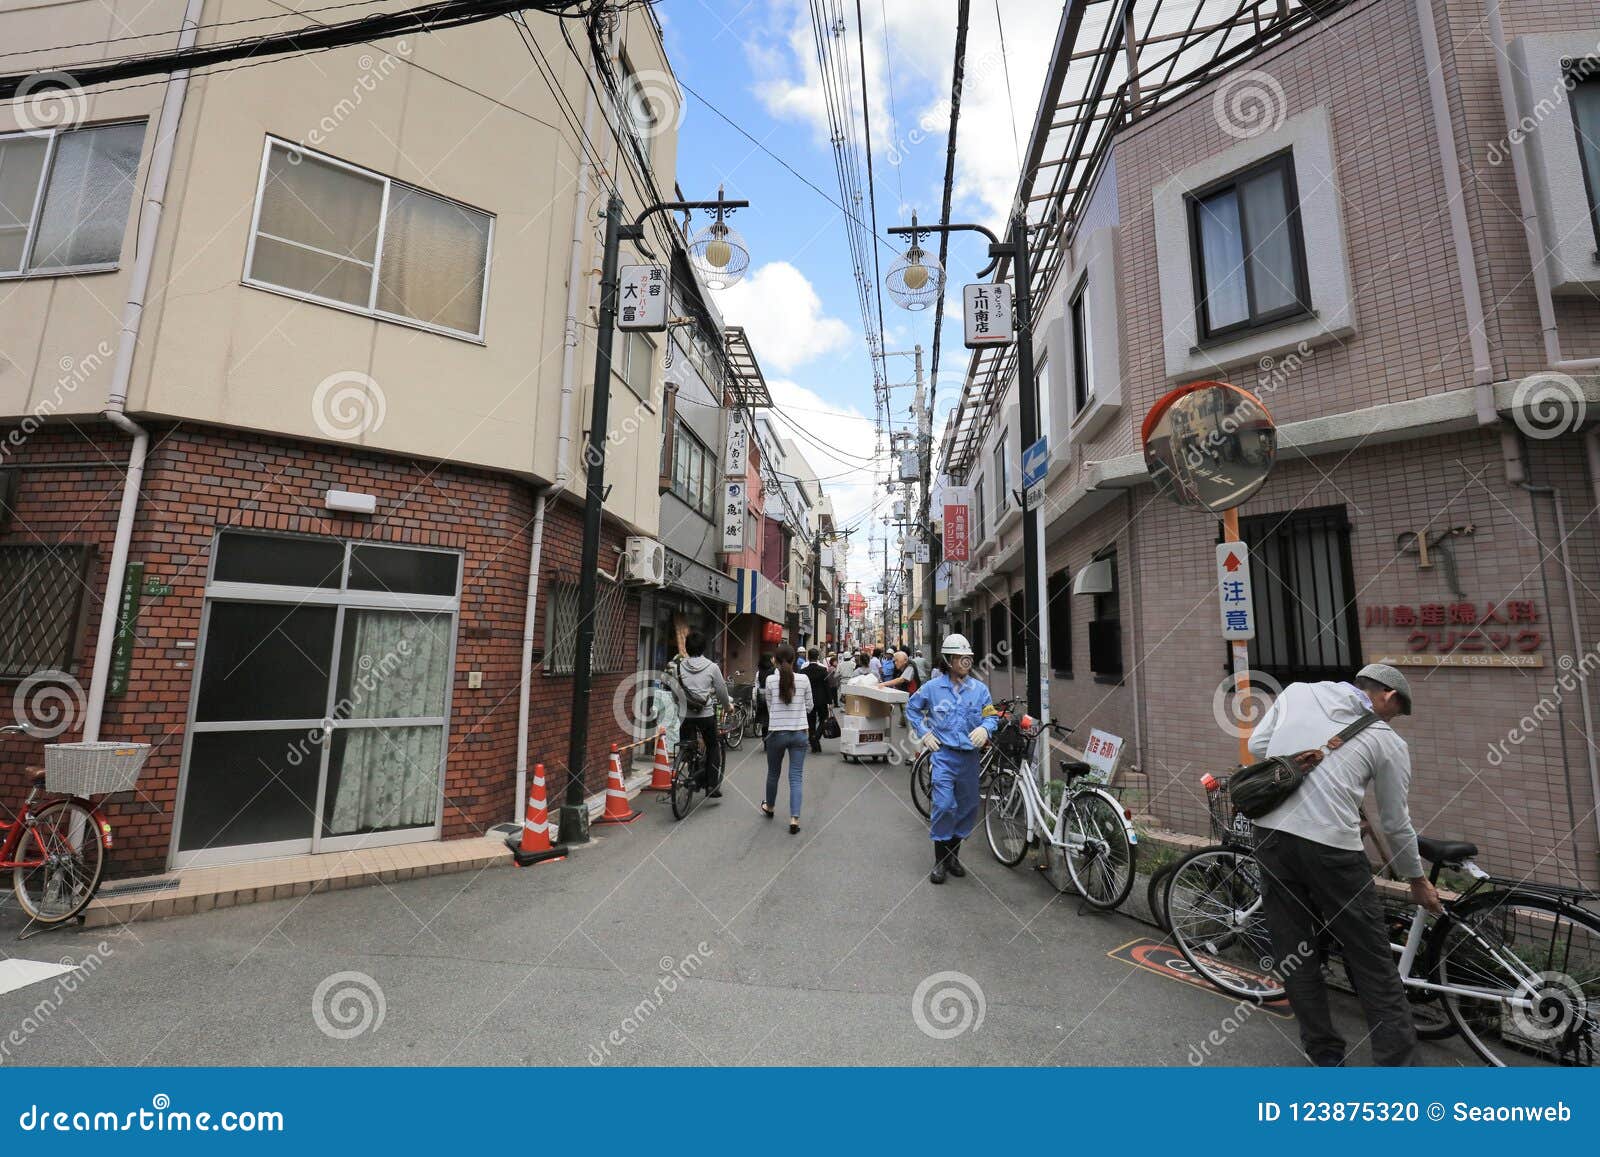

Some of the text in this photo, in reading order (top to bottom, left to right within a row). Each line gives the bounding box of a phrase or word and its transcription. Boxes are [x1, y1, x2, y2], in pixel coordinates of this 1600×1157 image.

[649, 269, 662, 296] 理容
[623, 282, 638, 322] 大富
[1223, 581, 1249, 631] 注意
[1365, 601, 1538, 628] 川島産婦人科
[1408, 630, 1542, 652] クリニック
[1401, 655, 1537, 665] 入口 TEL 6351-2374
